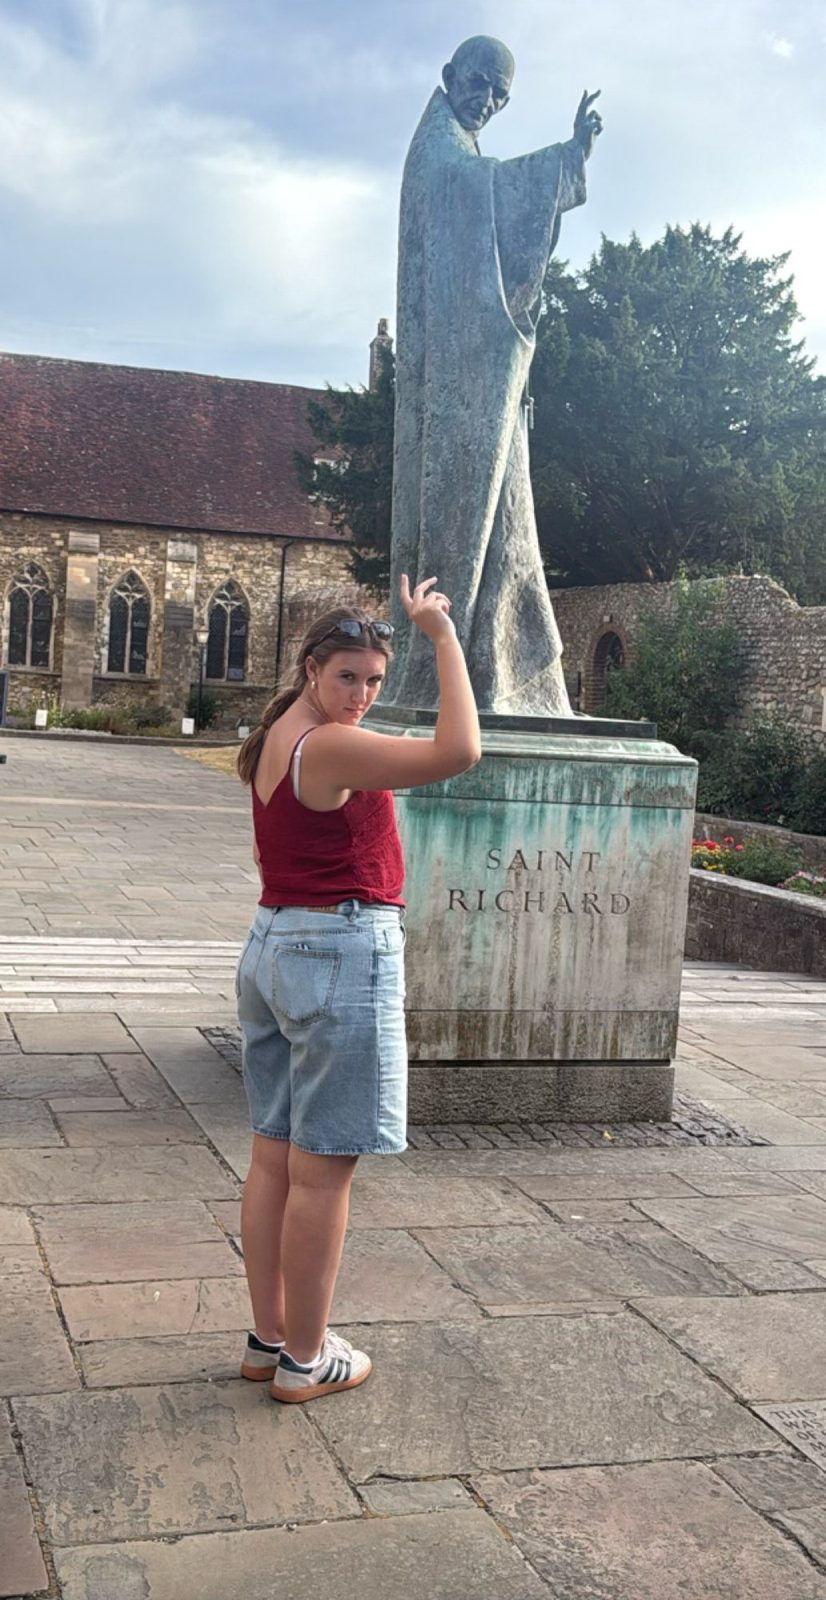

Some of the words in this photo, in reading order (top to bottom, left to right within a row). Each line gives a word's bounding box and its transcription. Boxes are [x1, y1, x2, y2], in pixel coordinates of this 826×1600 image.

[486, 848, 601, 872] SAINT
[448, 888, 631, 915] RICHARD
[769, 1409, 818, 1420] THIS
[782, 1419, 823, 1430] WAS
[796, 1430, 817, 1441] OF
